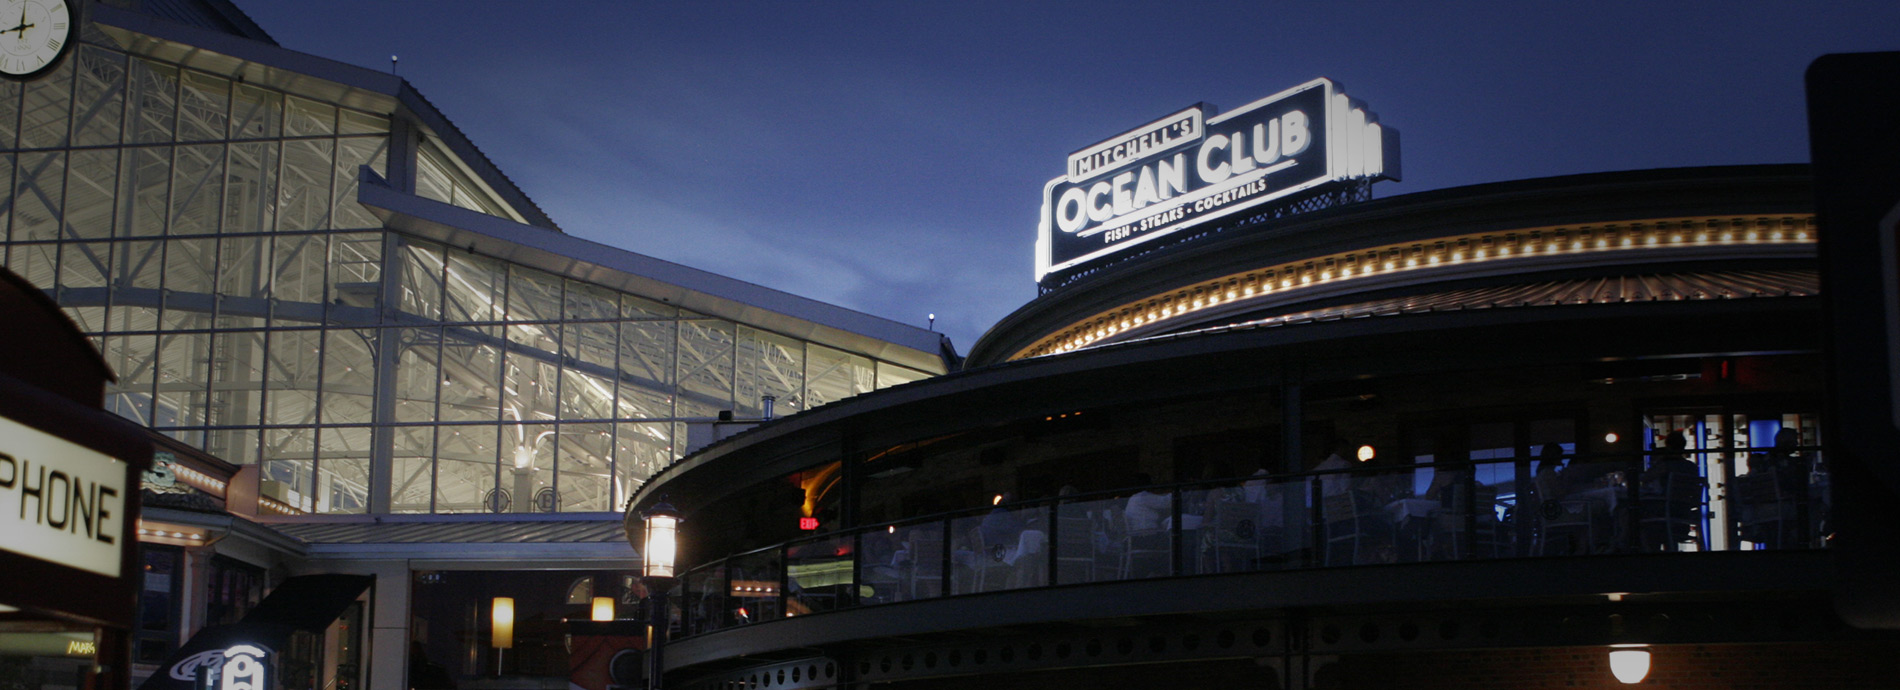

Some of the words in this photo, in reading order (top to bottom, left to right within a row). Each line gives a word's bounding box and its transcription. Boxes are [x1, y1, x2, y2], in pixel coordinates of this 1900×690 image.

[1056, 153, 1187, 233] OCEAN
[1196, 110, 1311, 184] CLUB
[1077, 119, 1192, 176] MITCHELL'S
[1104, 226, 1131, 244] FISH
[1140, 207, 1185, 232] STEAKS
[1194, 178, 1267, 213] COCKTAILS
